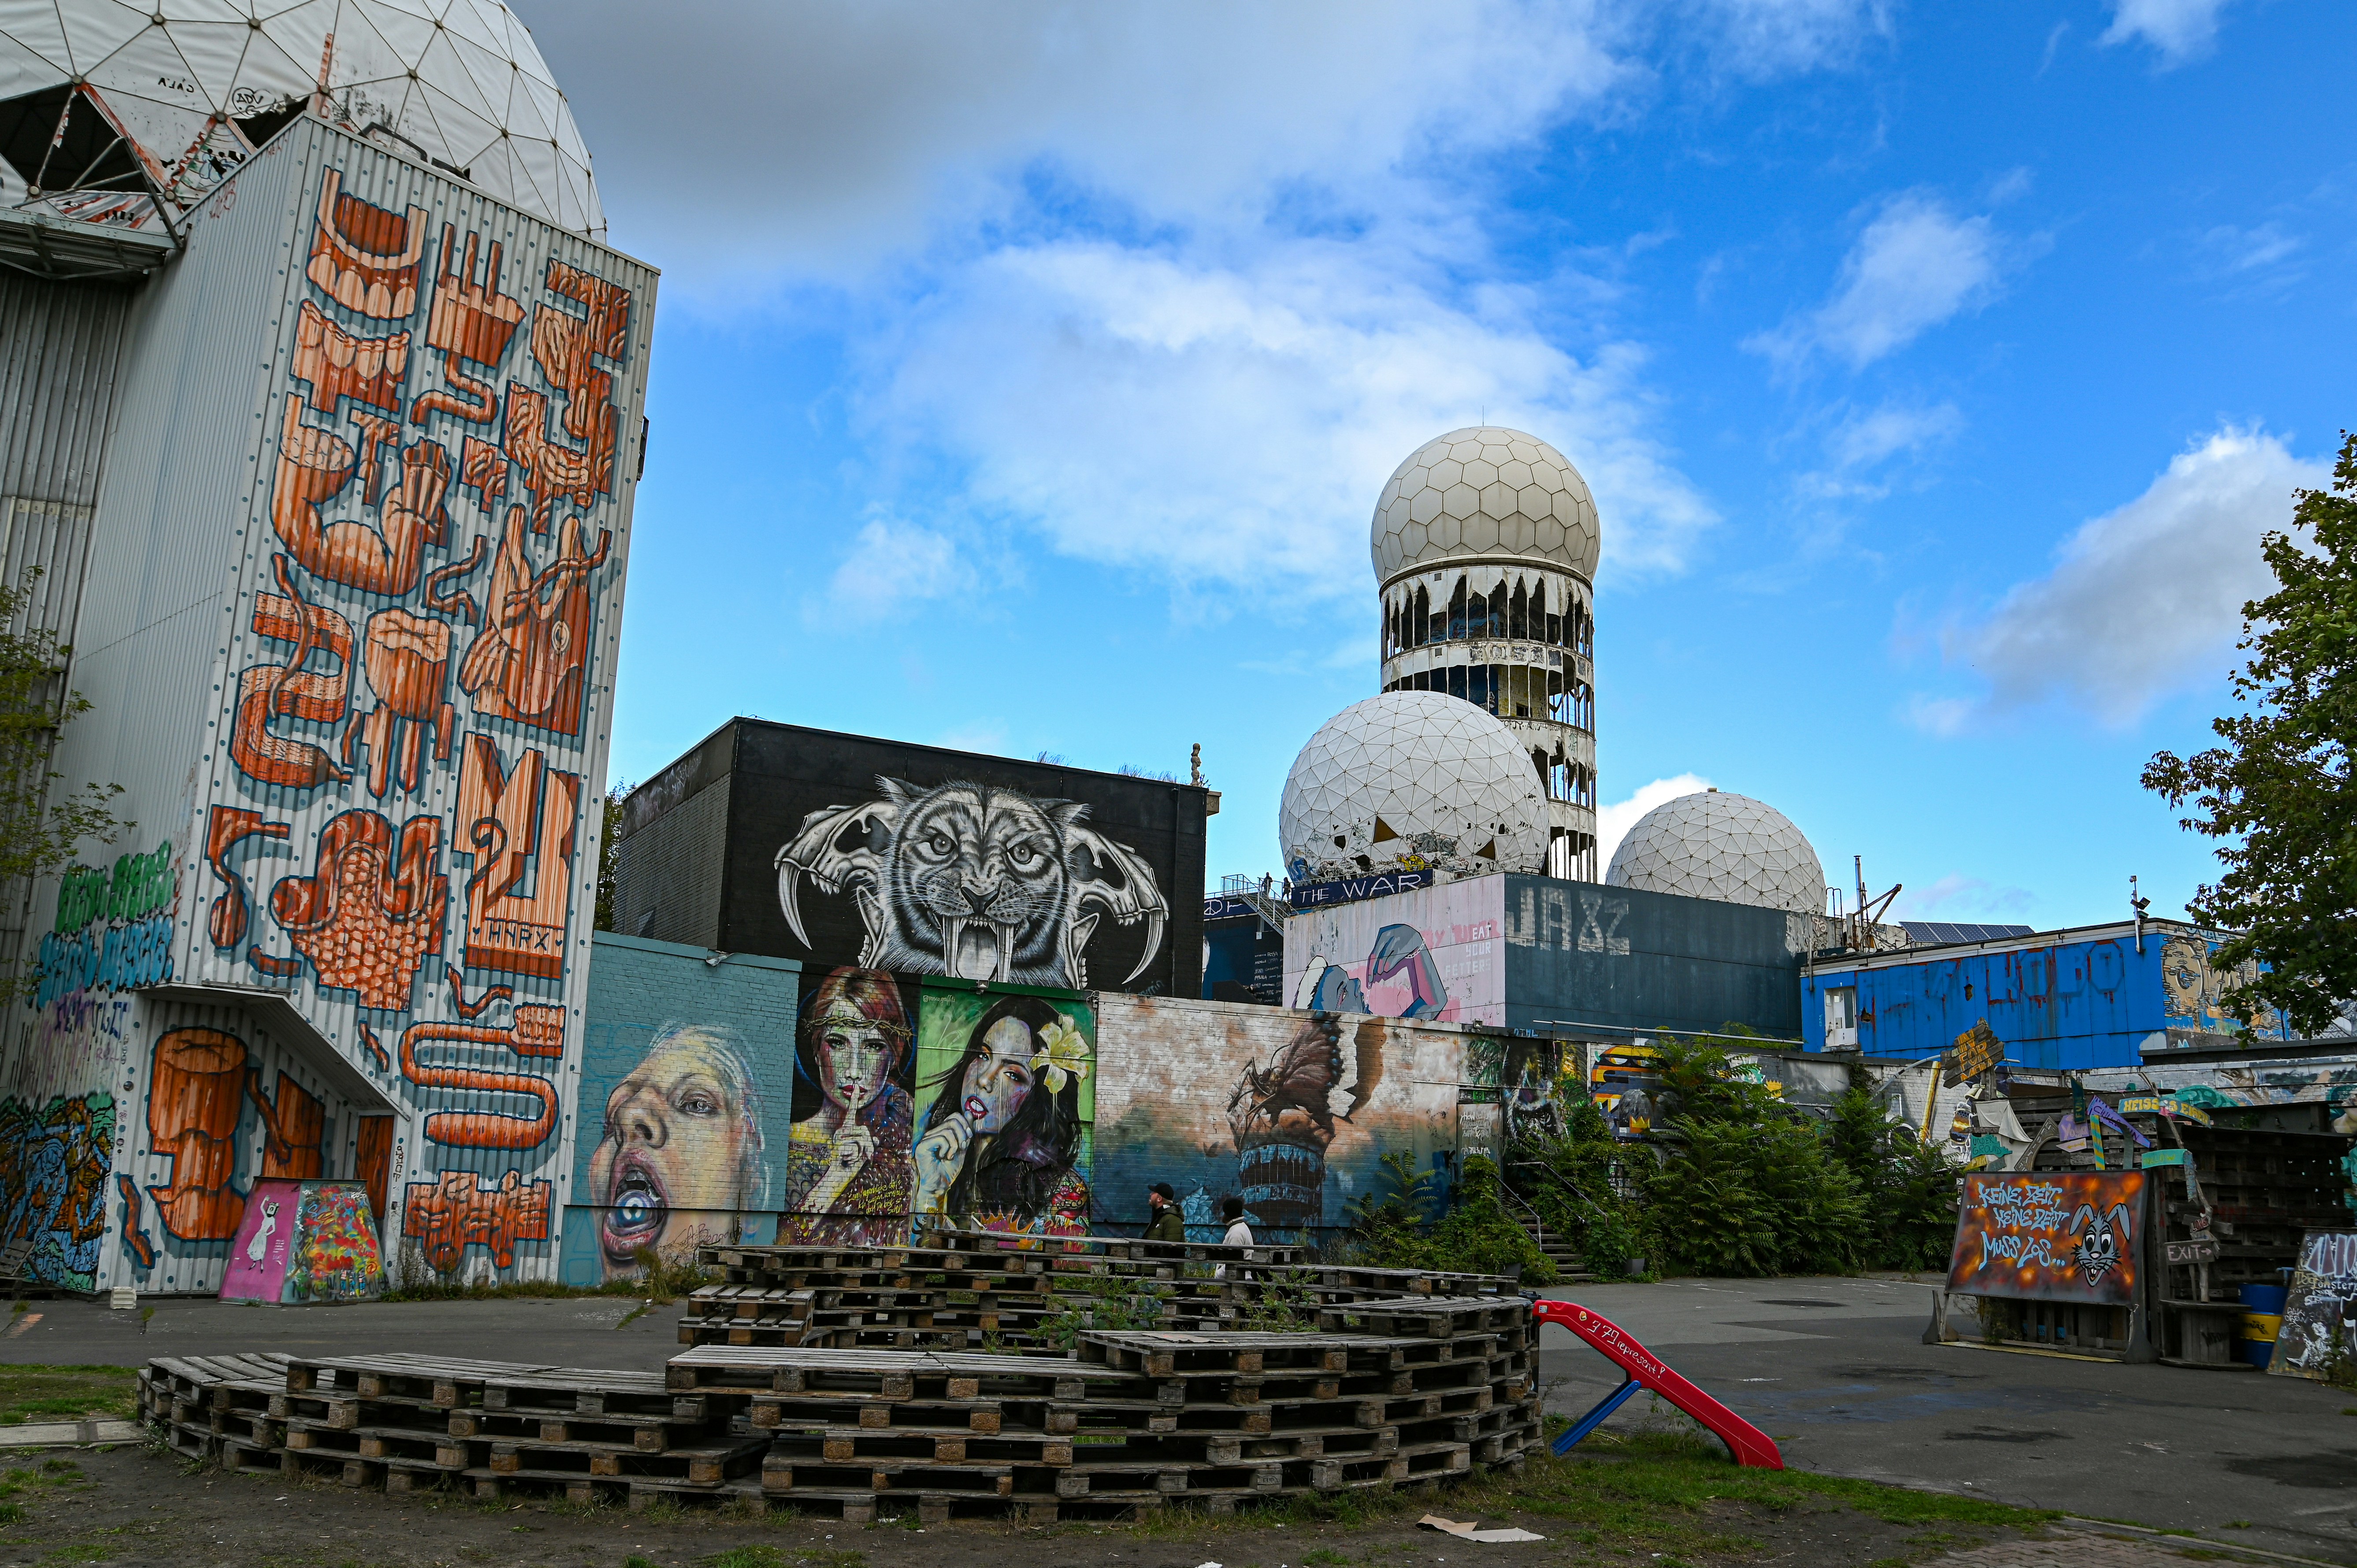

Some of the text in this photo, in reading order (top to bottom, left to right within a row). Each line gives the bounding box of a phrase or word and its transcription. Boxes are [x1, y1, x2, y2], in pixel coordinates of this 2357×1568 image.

[1300, 888, 1329, 904] THE
[1342, 874, 1422, 898] WAR
[1472, 924, 1492, 940] EAT
[1466, 942, 1491, 957] YOUR
[1445, 959, 1492, 978] FETTERS
[1958, 1029, 1975, 1053] IN
[1959, 1041, 1990, 1072] FOR
[2180, 1103, 2209, 1124] EISEN
[1973, 1136, 1995, 1145] UNDER
[2062, 1126, 2089, 1138] Yoga
[1972, 1144, 2002, 1155] GROUND
[1056, 1199, 1083, 1210] ROSCO
[1993, 1206, 2070, 1231] KEINE ZEIT
[1978, 1231, 2021, 1271] MUSS
[2167, 1244, 2201, 1261] EXIT
